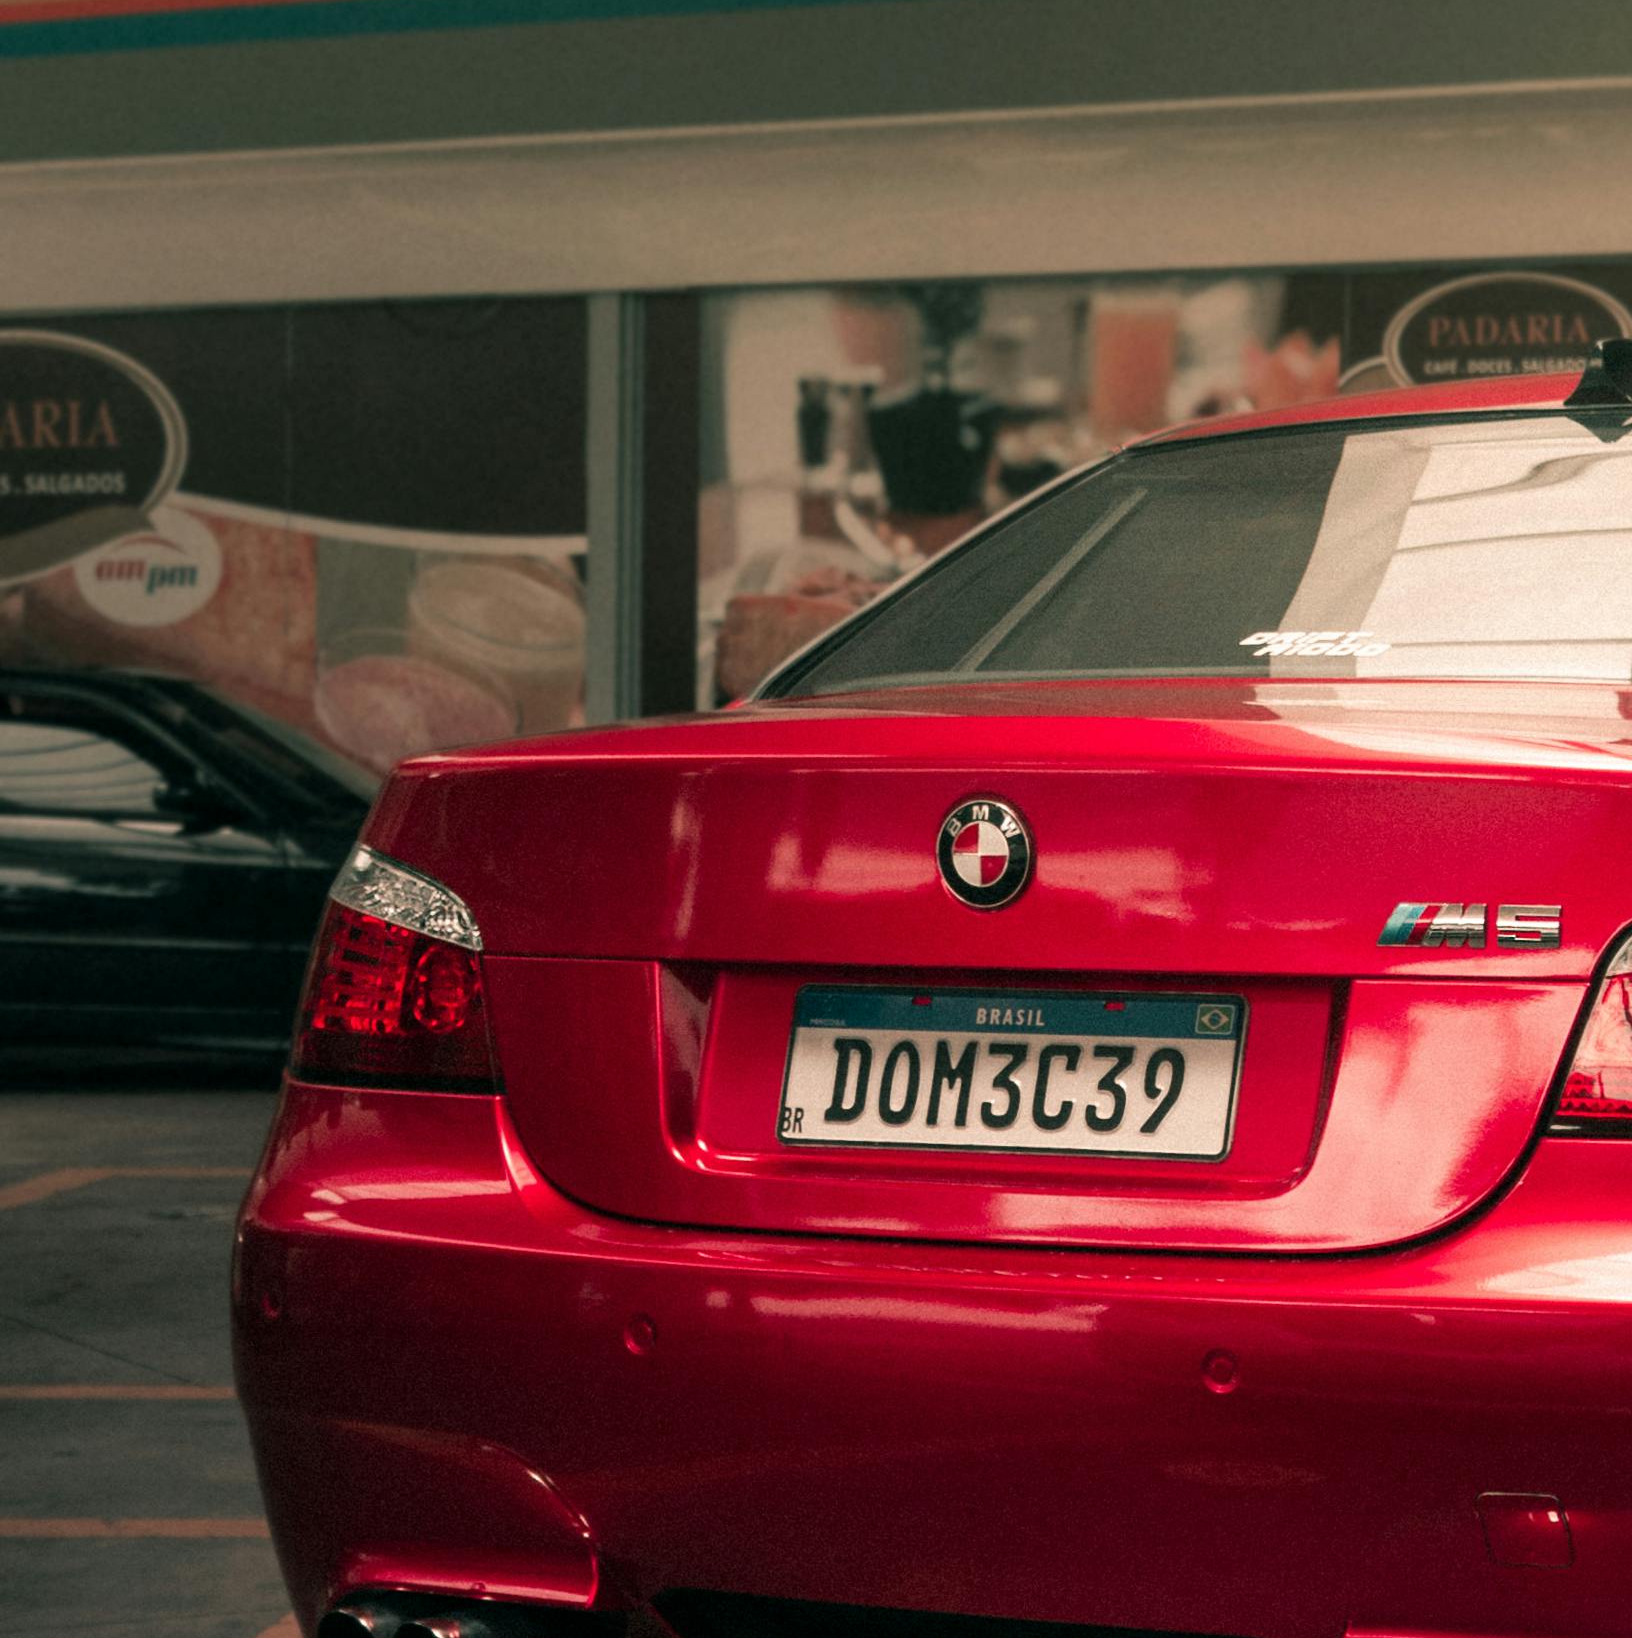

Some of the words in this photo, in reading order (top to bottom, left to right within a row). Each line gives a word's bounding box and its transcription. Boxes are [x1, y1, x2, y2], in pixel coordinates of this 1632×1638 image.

[1429, 314, 1590, 348] PADARIA
[1521, 355, 1588, 373] SALGADO
[25, 472, 125, 495] SALGADOS
[946, 804, 1022, 838] BMW
[975, 1007, 1046, 1027] BRASIL
[824, 1037, 1186, 1134] DOM3C39
[782, 1106, 805, 1134] BR
